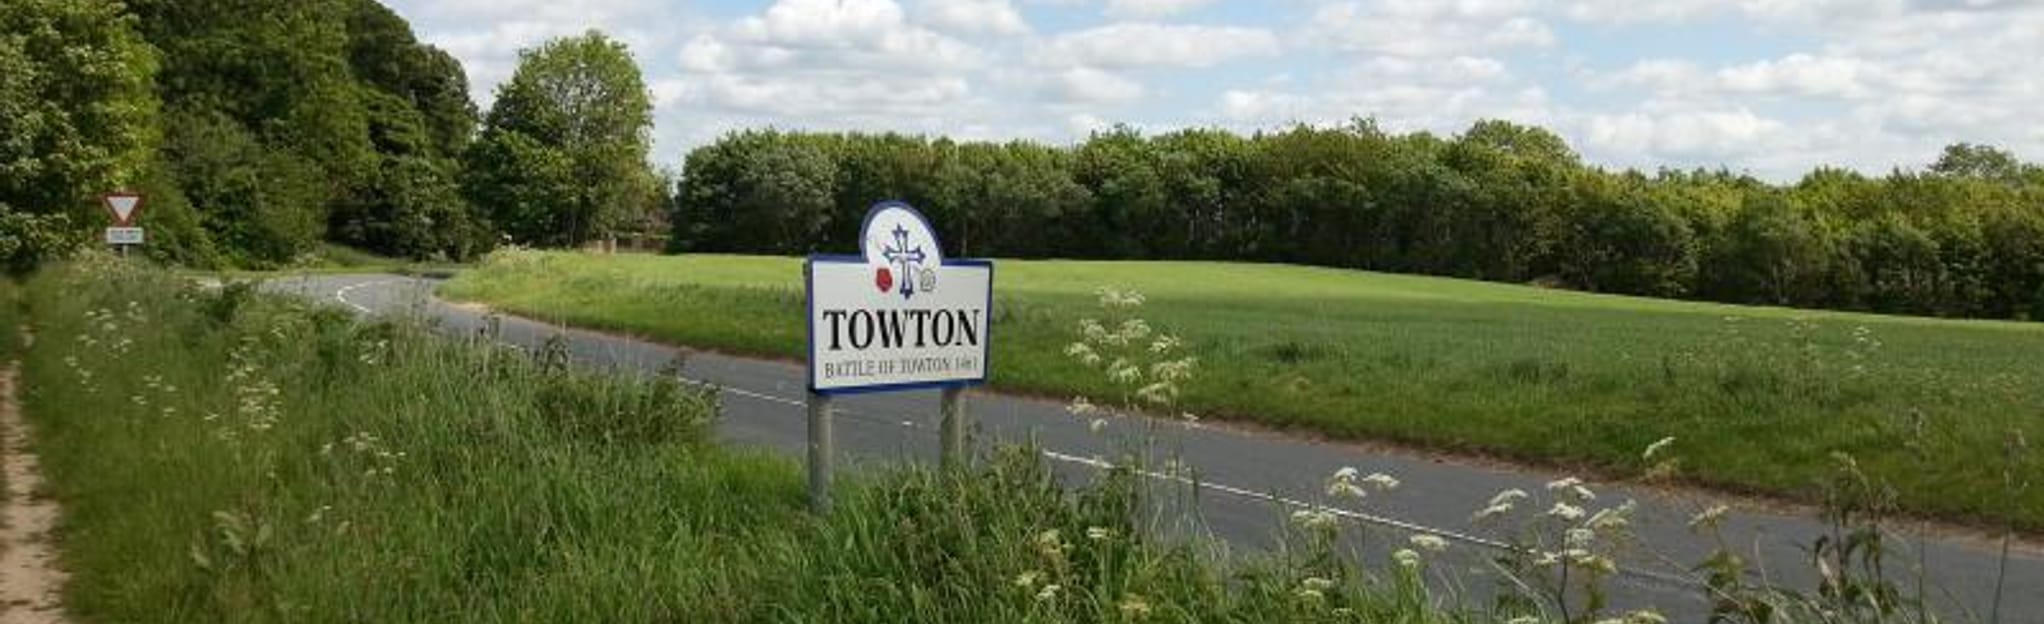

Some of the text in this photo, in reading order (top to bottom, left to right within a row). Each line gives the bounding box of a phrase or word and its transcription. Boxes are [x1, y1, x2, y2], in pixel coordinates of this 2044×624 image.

[823, 309, 980, 350] TOWTON
[825, 360, 874, 378] BATTLE
[879, 359, 894, 374] OF
[900, 357, 949, 373] TOWTON
